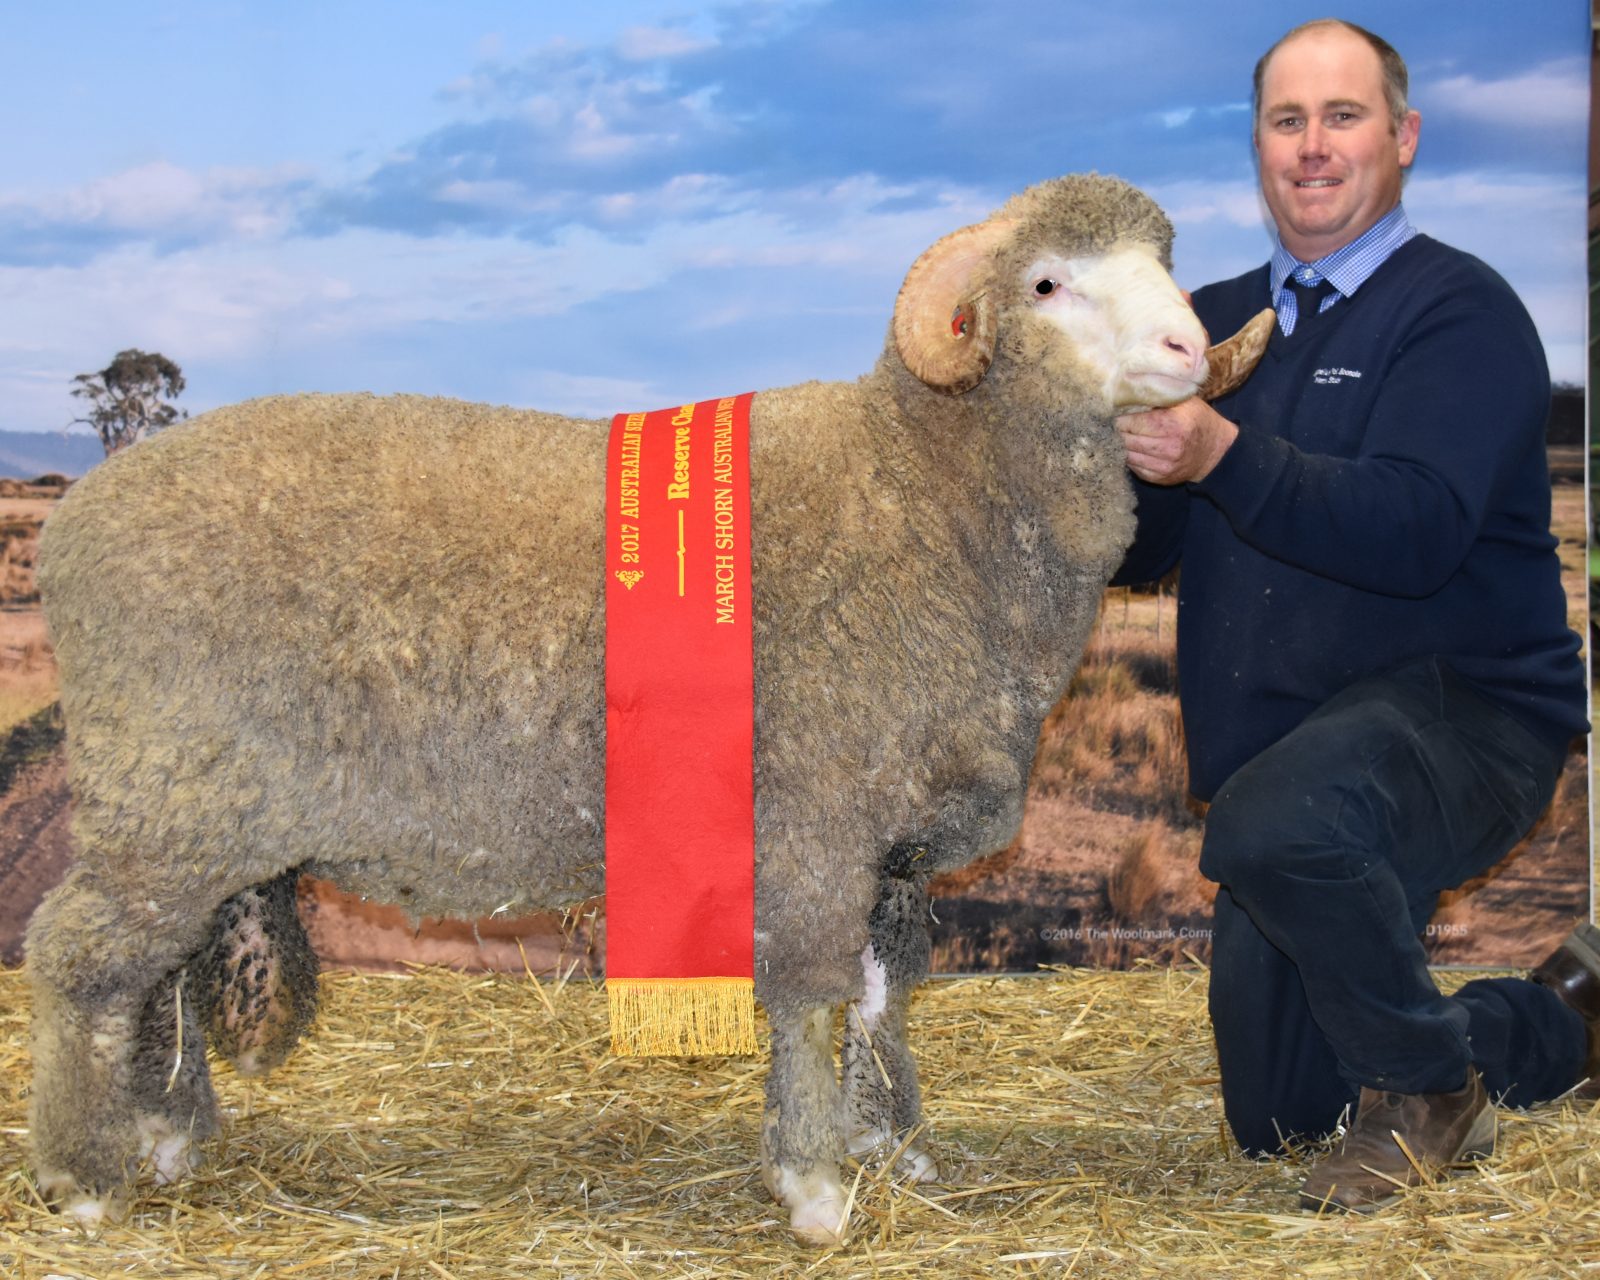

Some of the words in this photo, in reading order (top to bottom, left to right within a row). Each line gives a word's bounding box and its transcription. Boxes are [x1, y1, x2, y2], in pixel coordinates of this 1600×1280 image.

[621, 433, 641, 518] AUSTRALIAN
[668, 428, 690, 500] Reserve
[714, 411, 733, 484] AUSTRALIAN
[621, 524, 639, 564] 2017
[715, 489, 734, 549] SHORN
[716, 555, 734, 624] MARCH
[1086, 928, 1108, 939] The
[1111, 927, 1176, 939] Woolmark
